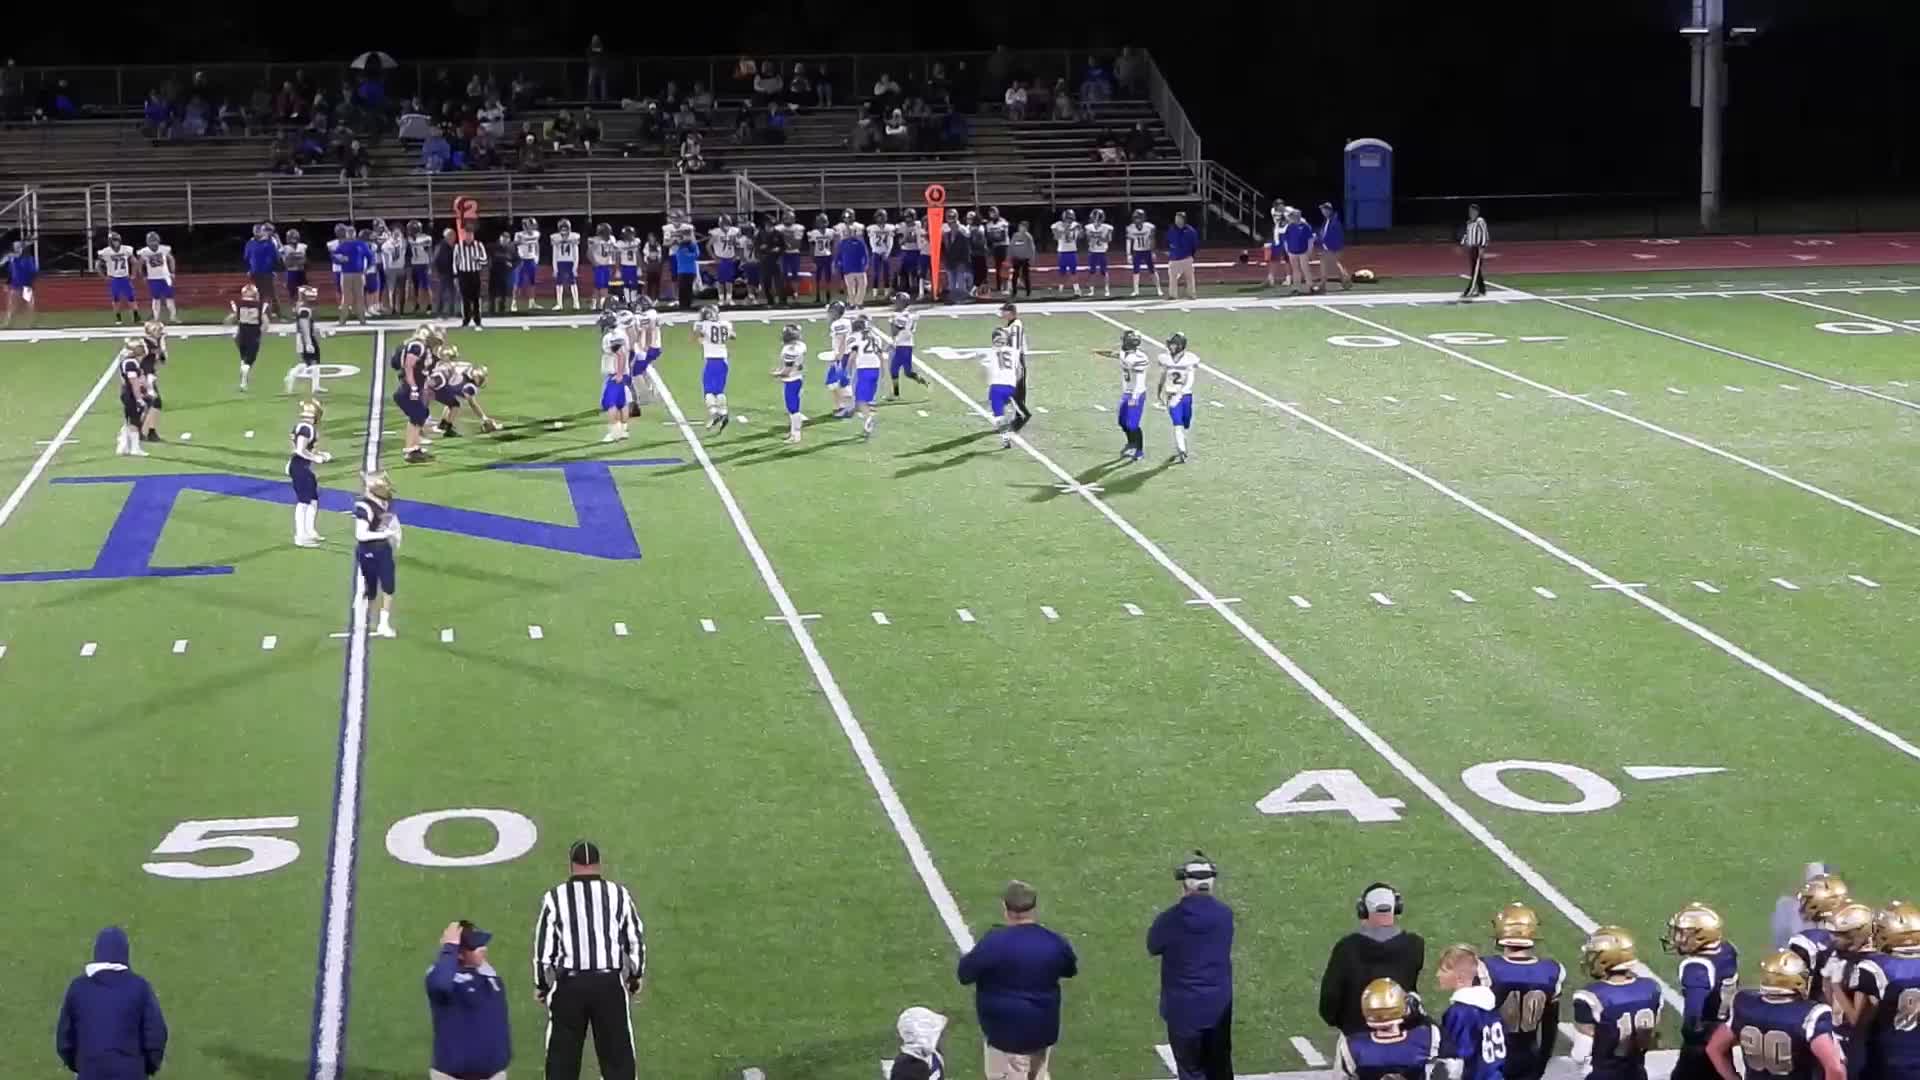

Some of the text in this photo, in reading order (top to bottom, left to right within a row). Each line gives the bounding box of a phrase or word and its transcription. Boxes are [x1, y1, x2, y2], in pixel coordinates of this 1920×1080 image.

[112, 256, 127, 271] 72
[710, 325, 728, 344] 88
[1172, 372, 1182, 386] 2
[1257, 759, 1622, 824] 4 0
[142, 808, 538, 879] 5 0
[1482, 1021, 1507, 1063] 69
